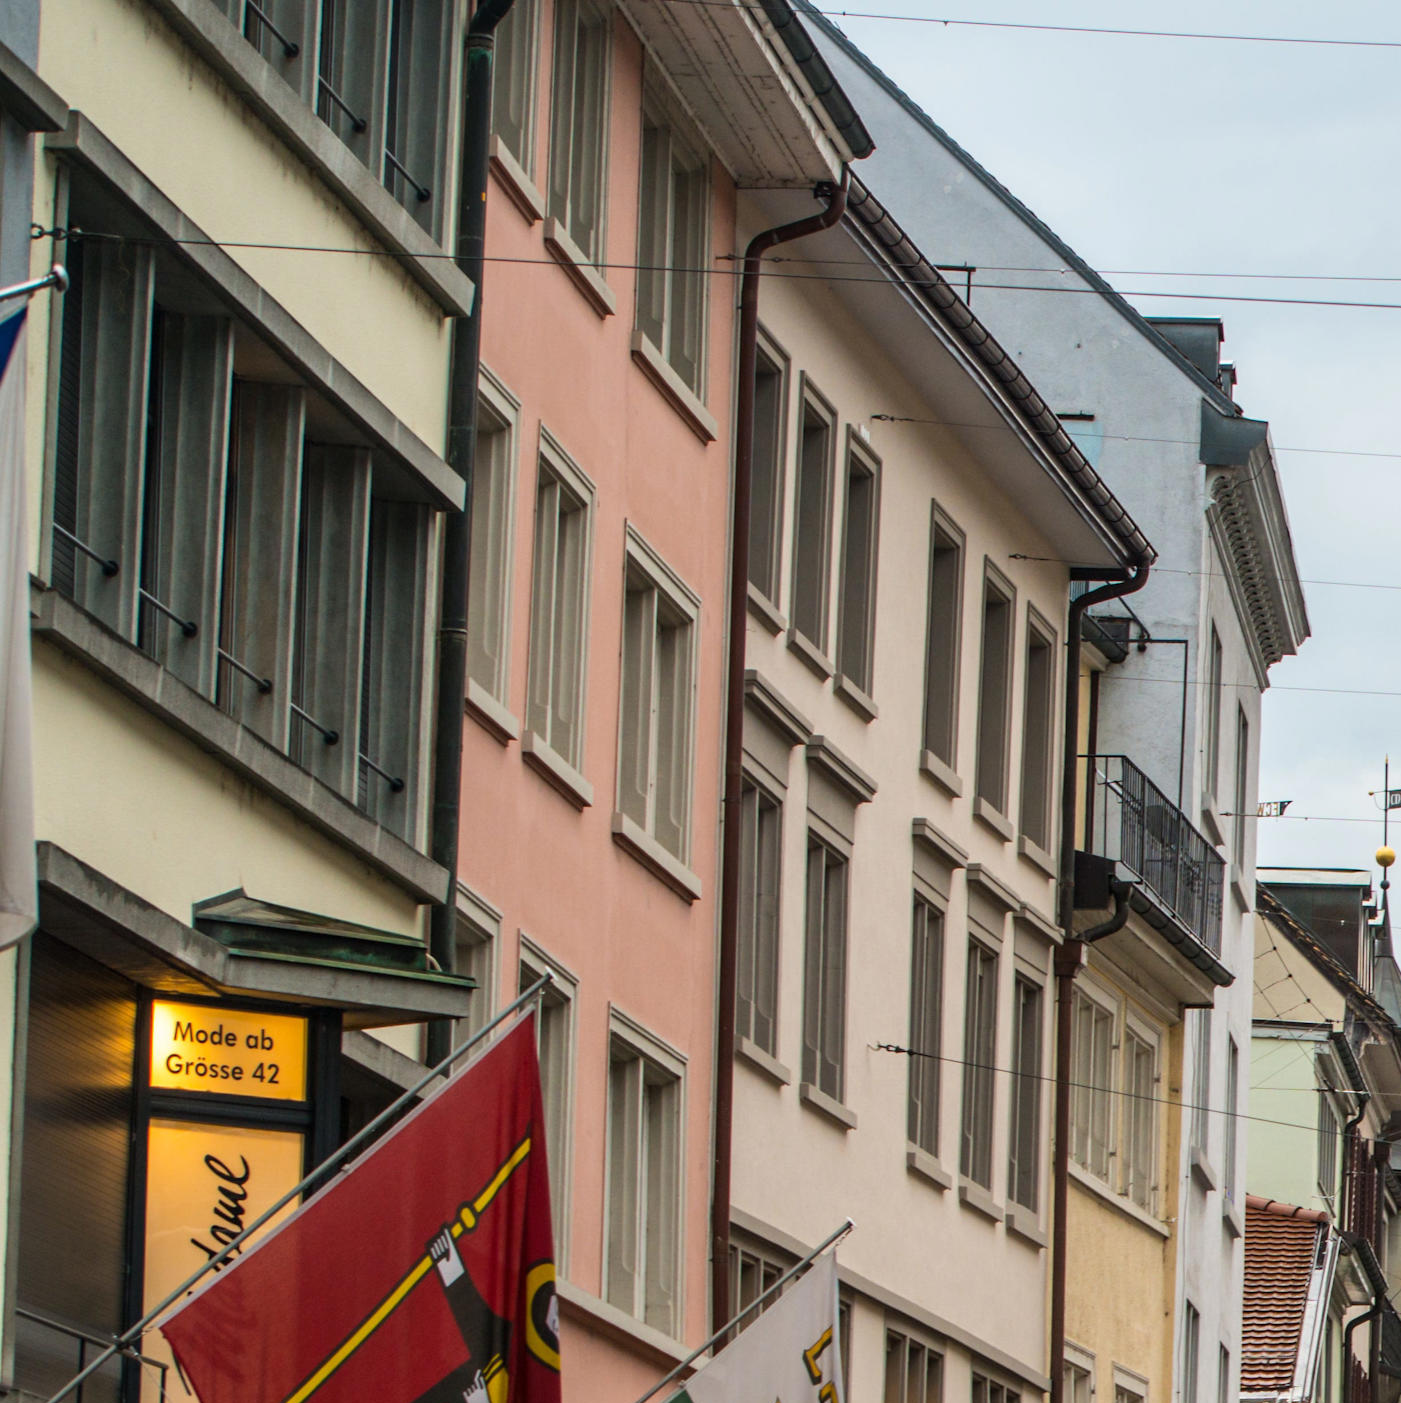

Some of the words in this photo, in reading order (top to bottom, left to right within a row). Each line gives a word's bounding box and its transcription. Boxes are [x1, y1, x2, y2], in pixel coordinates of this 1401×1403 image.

[173, 1020, 238, 1048] Mode
[245, 1029, 274, 1051] ab
[165, 1053, 245, 1081] Grösse
[251, 1063, 280, 1085] 42
